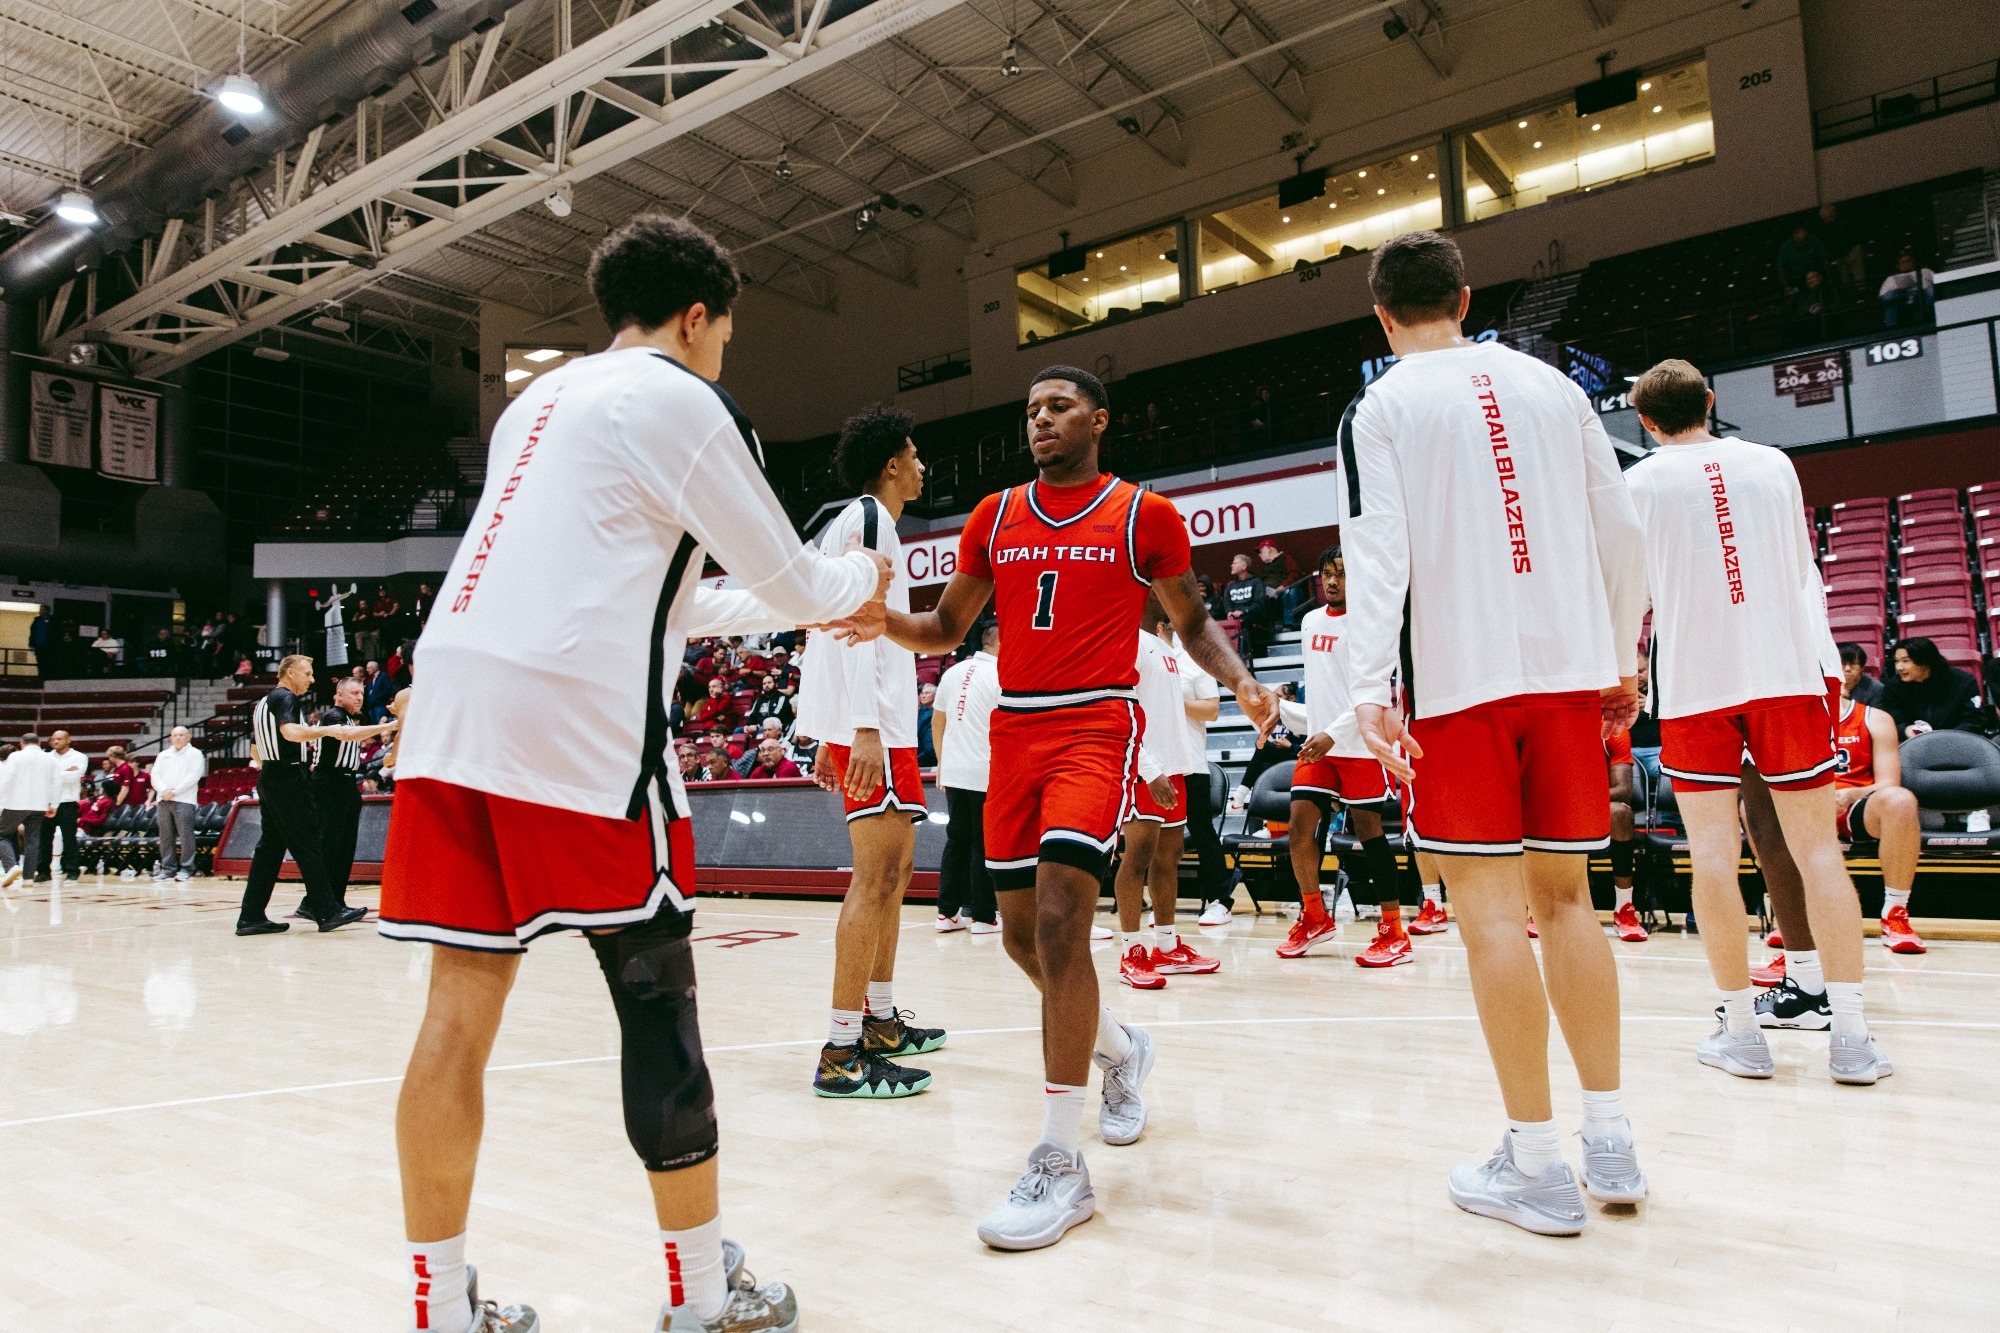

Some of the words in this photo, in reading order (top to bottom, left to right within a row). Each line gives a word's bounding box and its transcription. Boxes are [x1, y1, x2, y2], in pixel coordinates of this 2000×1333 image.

[1740, 69, 1772, 89] 205
[1299, 267, 1320, 282] 204
[984, 300, 1000, 313] 203
[1868, 339, 1919, 363] 103
[482, 373, 500, 383] 201
[1471, 374, 1492, 388] 23
[1778, 374, 1810, 389] 204
[1704, 462, 1721, 473] 20
[1478, 390, 1532, 574] TRAILBLAZERS
[452, 403, 554, 613] TRAILBLAZERS
[1708, 473, 1745, 605] TRAILBLAZERS
[996, 546, 1049, 565] UTAH
[1054, 546, 1116, 563] TECH
[1031, 570, 1059, 631] 1
[1311, 634, 1339, 653] UT
[150, 649, 168, 658] 115
[255, 649, 273, 658] 115
[957, 694, 968, 721] TECH
[1837, 736, 1860, 744] ECH
